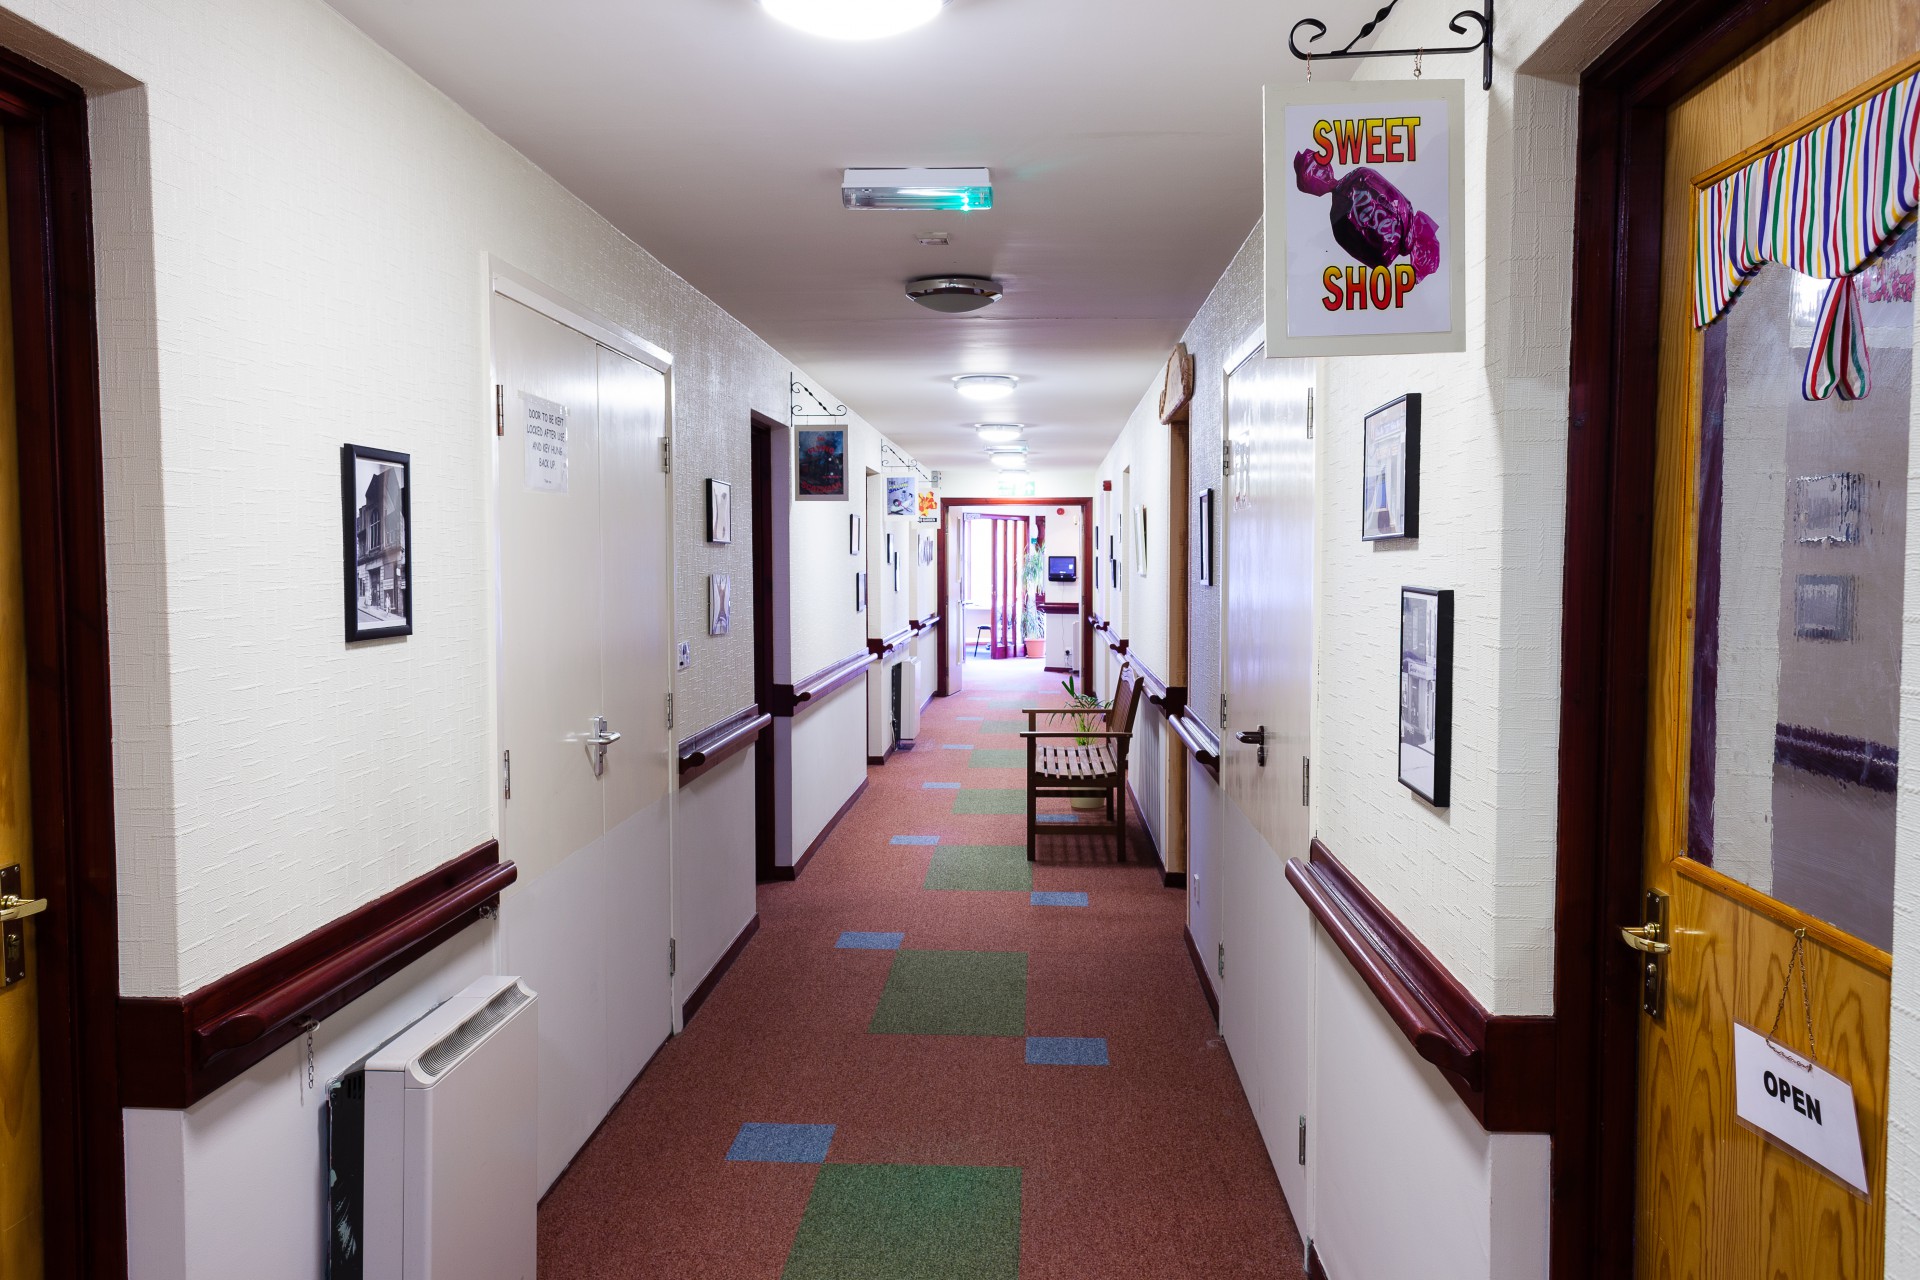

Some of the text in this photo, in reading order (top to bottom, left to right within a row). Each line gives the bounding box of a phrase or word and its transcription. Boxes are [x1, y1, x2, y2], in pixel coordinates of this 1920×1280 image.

[1313, 116, 1421, 166] SWEET
[1353, 187, 1401, 243] Roses
[1322, 263, 1416, 311] SHOP
[526, 424, 543, 437] LOCKED
[544, 428, 557, 439] AFTER
[528, 408, 541, 420] DOOR
[542, 412, 548, 422] TO
[549, 414, 554, 424] BE
[538, 458, 549, 468] BACK
[551, 445, 563, 456] HUNG
[1763, 1070, 1822, 1126] OPEN
